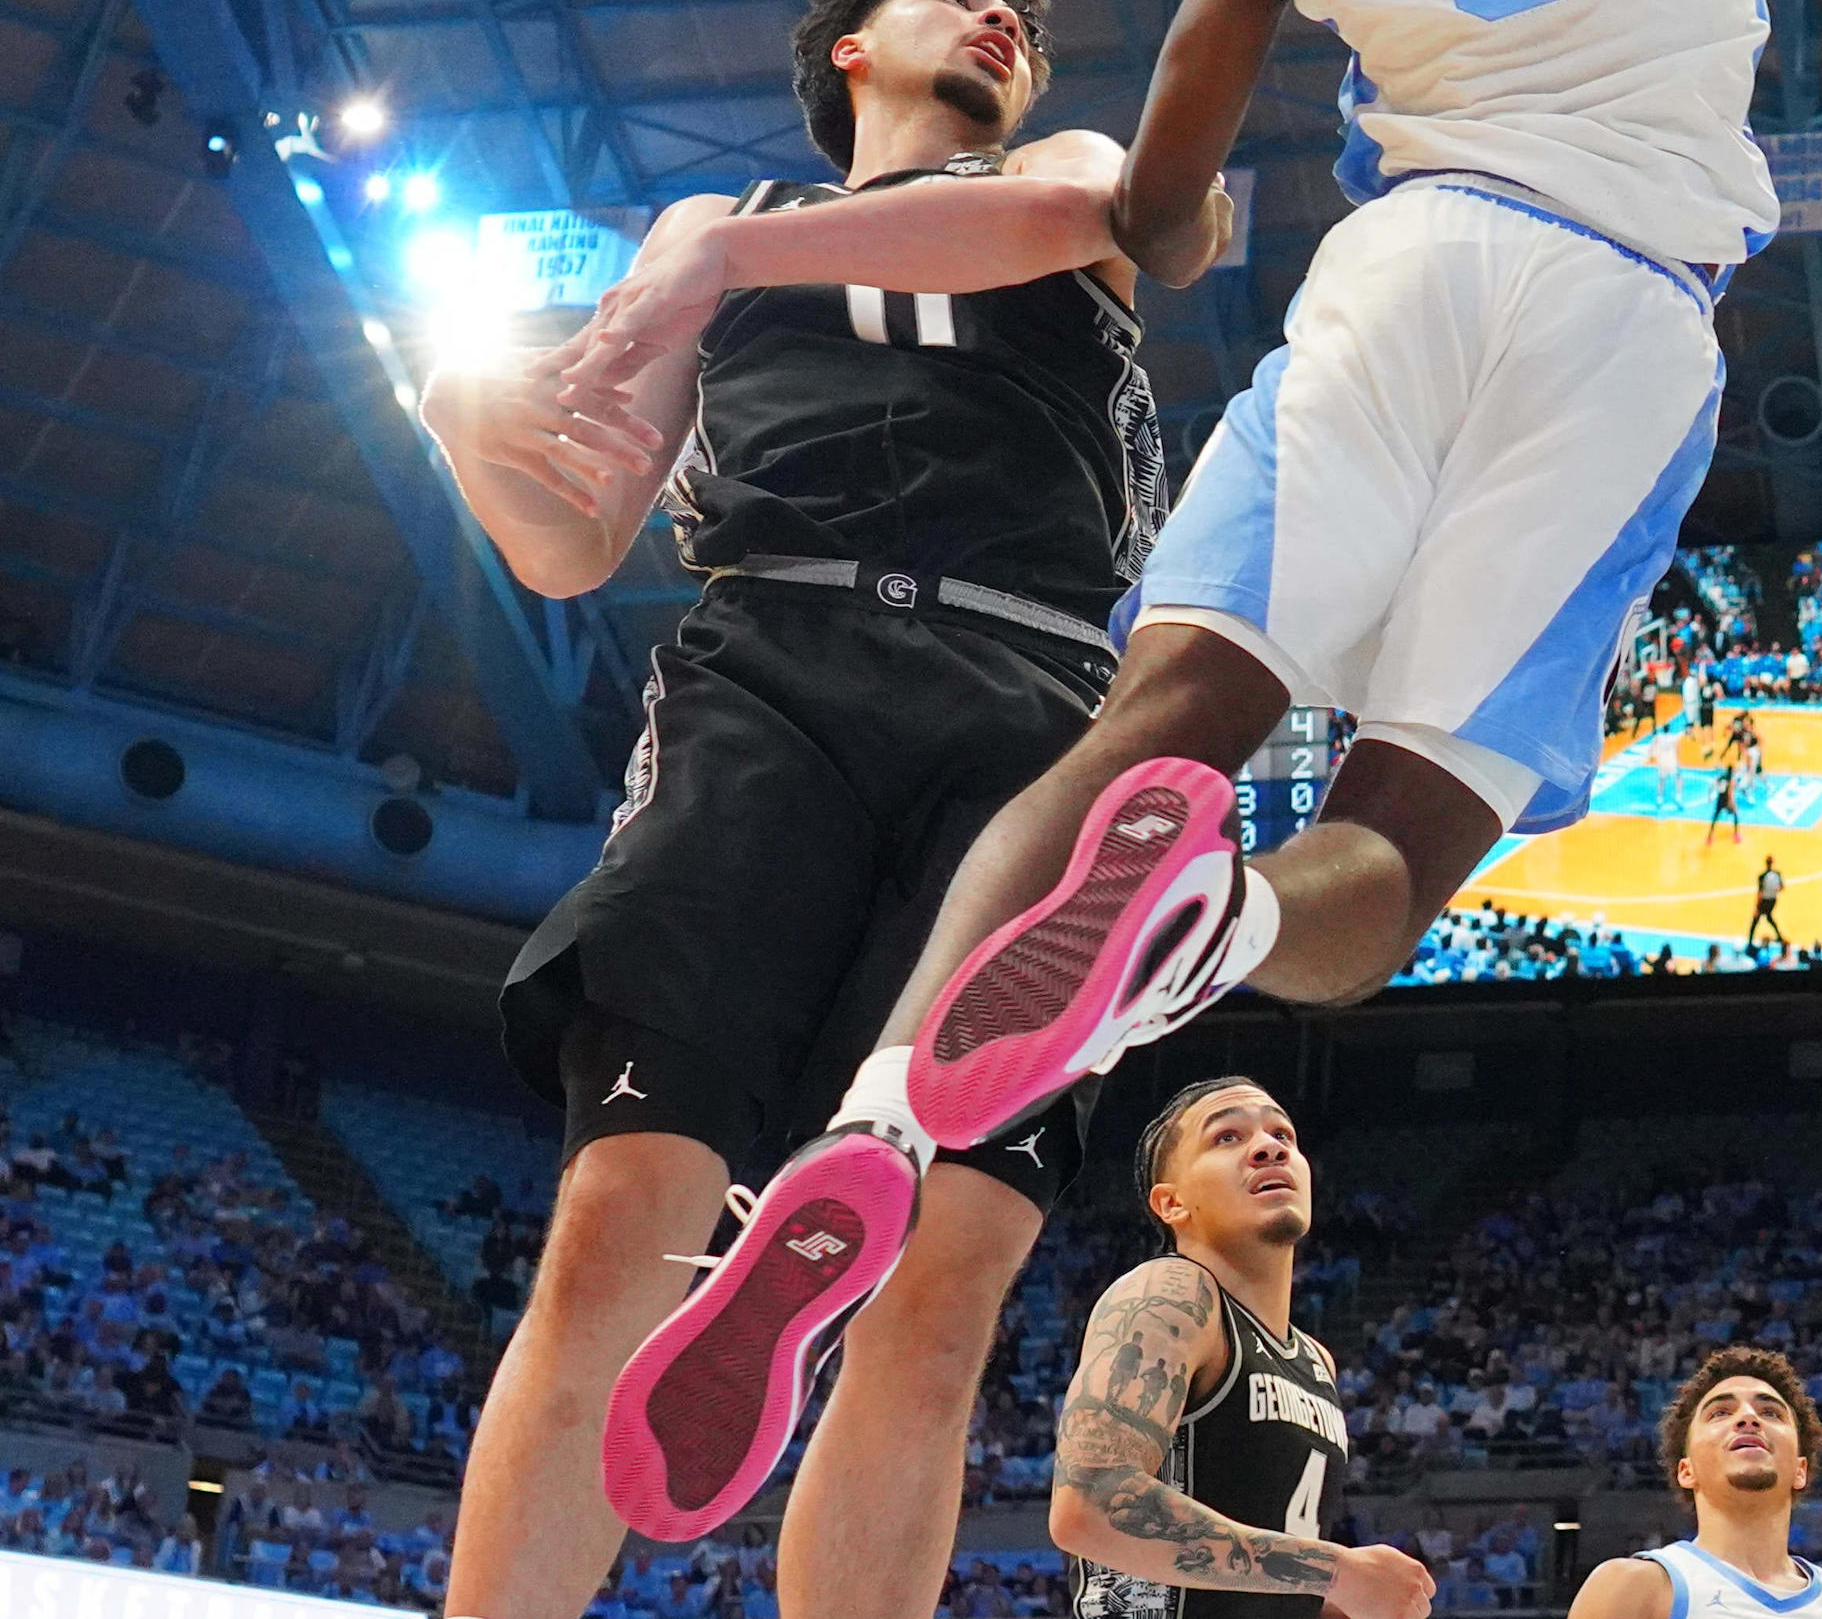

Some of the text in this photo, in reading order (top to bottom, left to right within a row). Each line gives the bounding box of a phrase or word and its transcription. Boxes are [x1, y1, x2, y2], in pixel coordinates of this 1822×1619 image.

[1291, 711, 1314, 742] 4
[1291, 748, 1314, 779] 2
[1291, 783, 1314, 813] 0
[1284, 1447, 1328, 1540] 4
